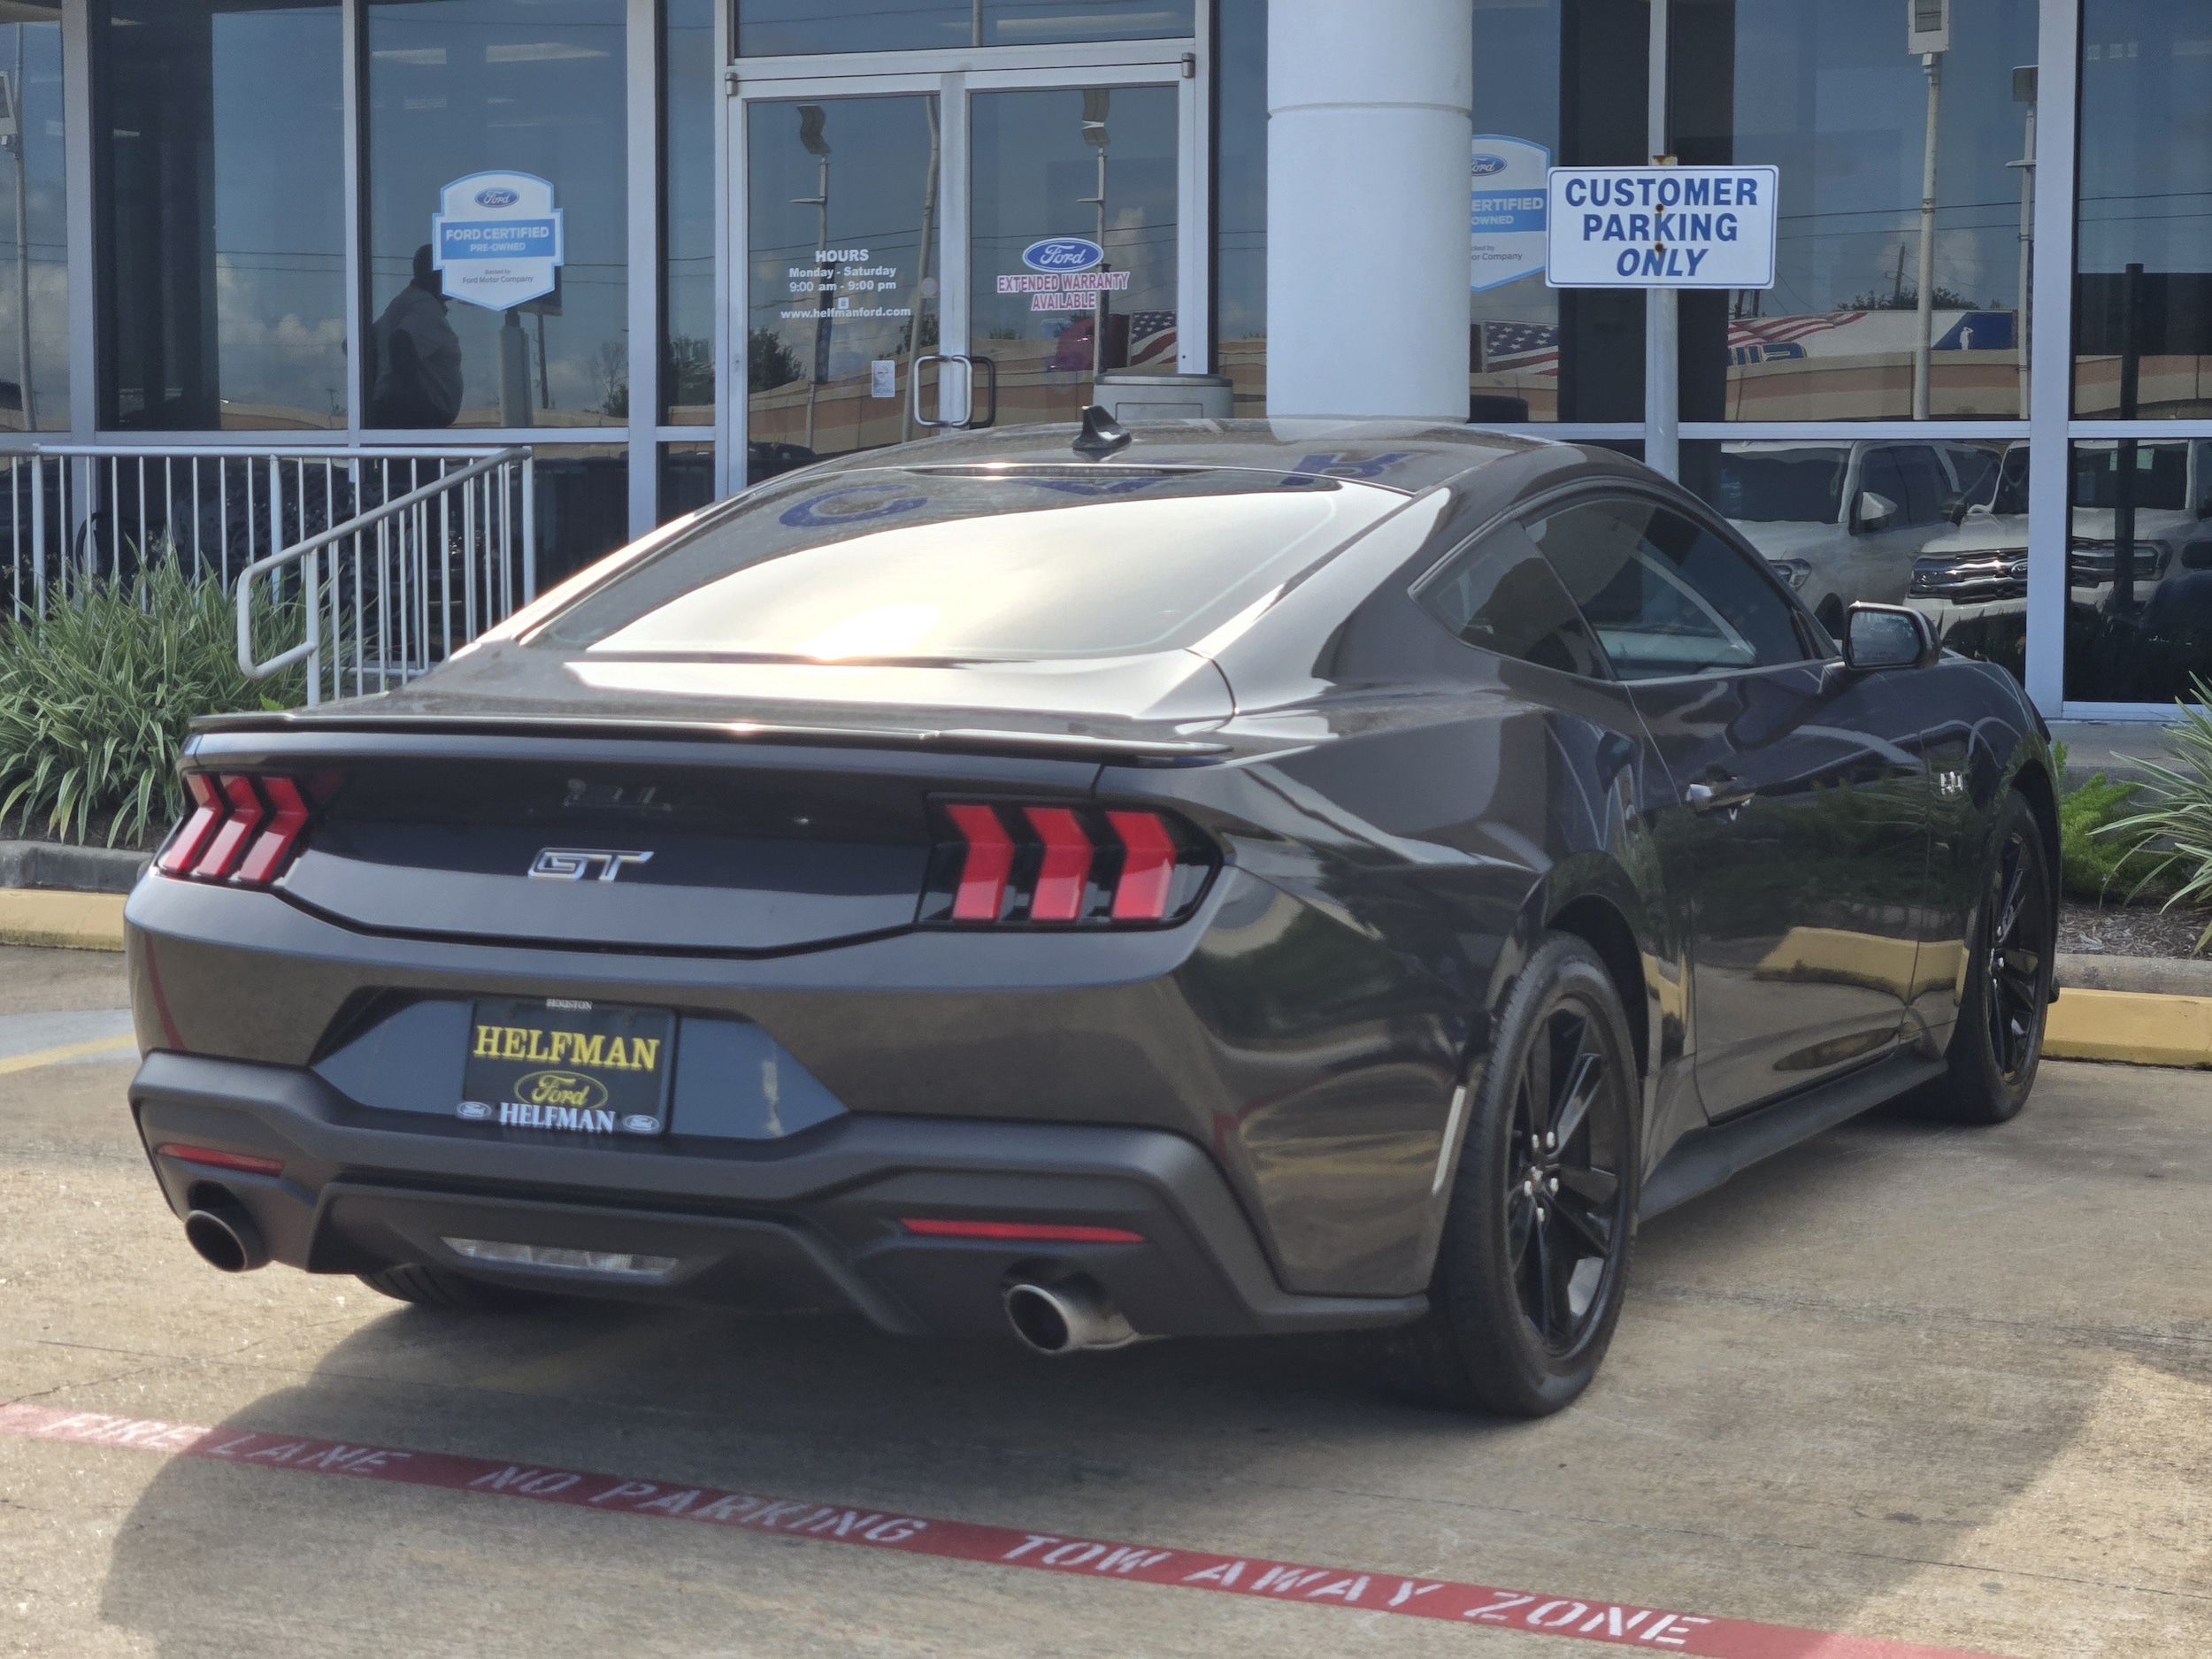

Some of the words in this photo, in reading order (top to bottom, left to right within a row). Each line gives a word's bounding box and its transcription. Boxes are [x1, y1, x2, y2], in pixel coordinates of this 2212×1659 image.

[484, 190, 510, 204] Ford
[1565, 178, 1758, 207] CUSTOMER
[1471, 197, 1544, 211] ERTIFIED
[1471, 215, 1514, 226] OWNED
[1583, 213, 1738, 242] PARKING
[446, 229, 480, 241] FORD
[484, 227, 549, 239] CERTIFIED
[471, 242, 526, 252] PRE-OWNED
[1041, 244, 1086, 265] Ford
[815, 249, 870, 263] HOURS
[1482, 252, 1522, 262] Company
[1617, 248, 1709, 277] ONLY
[501, 275, 534, 284] Company
[788, 267, 834, 280] Monday
[843, 265, 897, 278] Saturday
[789, 281, 814, 293] 9:00
[818, 282, 837, 291] am
[848, 280, 874, 290] 9:00
[878, 281, 896, 292] pm
[998, 274, 1058, 292] EXTENDED
[1063, 273, 1129, 290] WARRANTY
[1033, 293, 1095, 310] AVAILABLE
[780, 306, 911, 319] www.helfmanford.com
[528, 847, 655, 881] GT
[473, 1025, 660, 1071] HELFMAN
[532, 1074, 590, 1106] Ford
[499, 1102, 616, 1134] HELFMAN
[37, 1413, 212, 1449] FIRE
[208, 1433, 412, 1474] LANE
[467, 1465, 581, 1496] NO
[588, 1479, 927, 1543] PARKING
[1002, 1533, 1173, 1574] TOW
[1184, 1561, 1444, 1608] AWAY
[1462, 1591, 1714, 1646] ZONE
